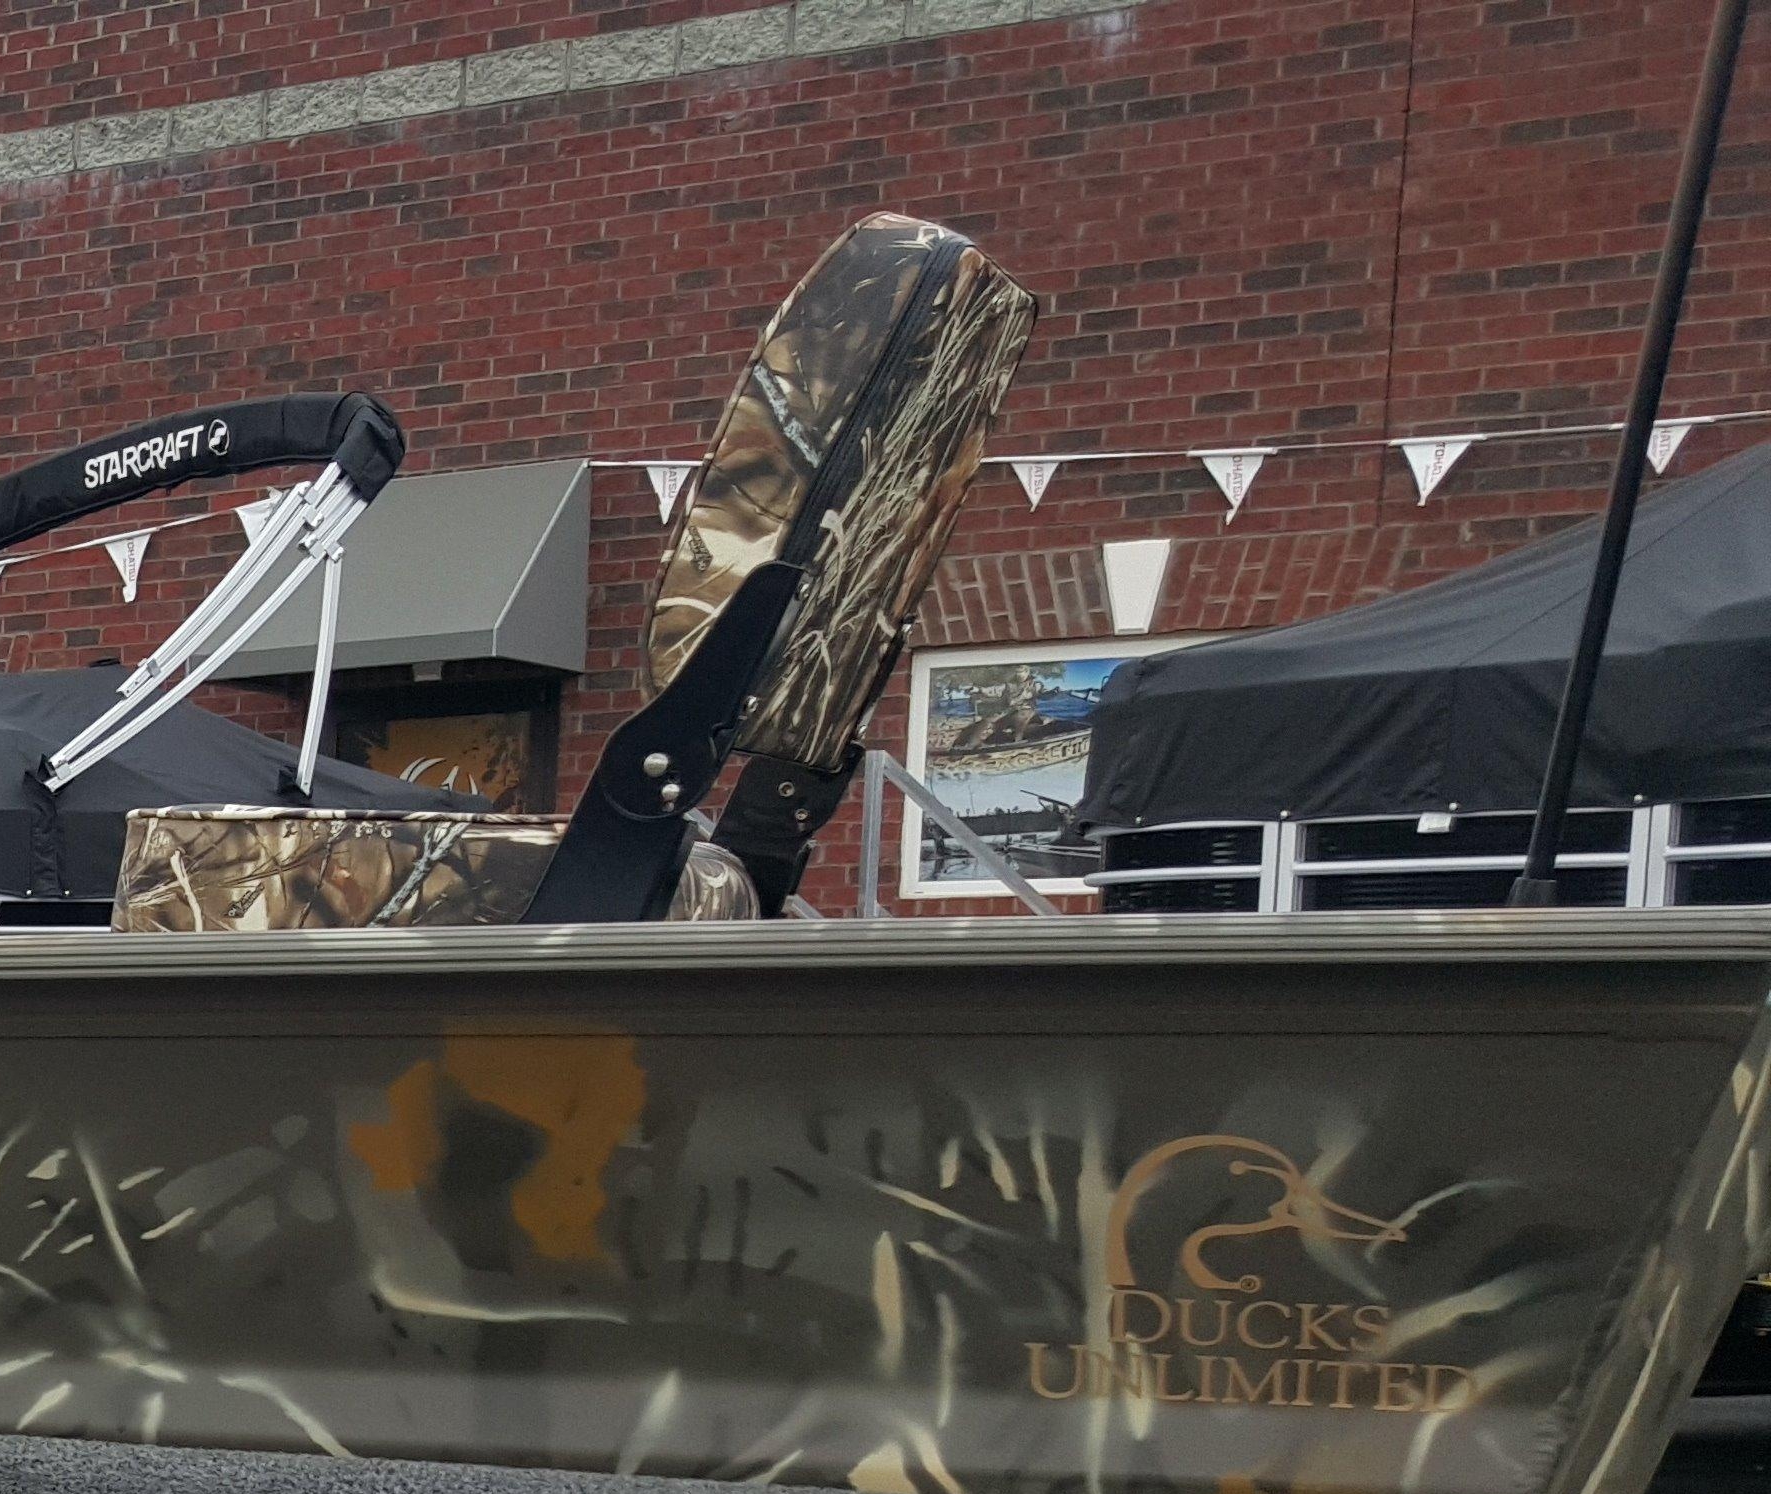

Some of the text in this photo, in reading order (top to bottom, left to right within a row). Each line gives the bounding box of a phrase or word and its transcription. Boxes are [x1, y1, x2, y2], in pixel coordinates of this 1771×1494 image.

[84, 424, 204, 489] STARCRAFT
[1109, 1287, 1390, 1353] DUCKS
[1024, 1342, 1476, 1413] UNLIMITED
